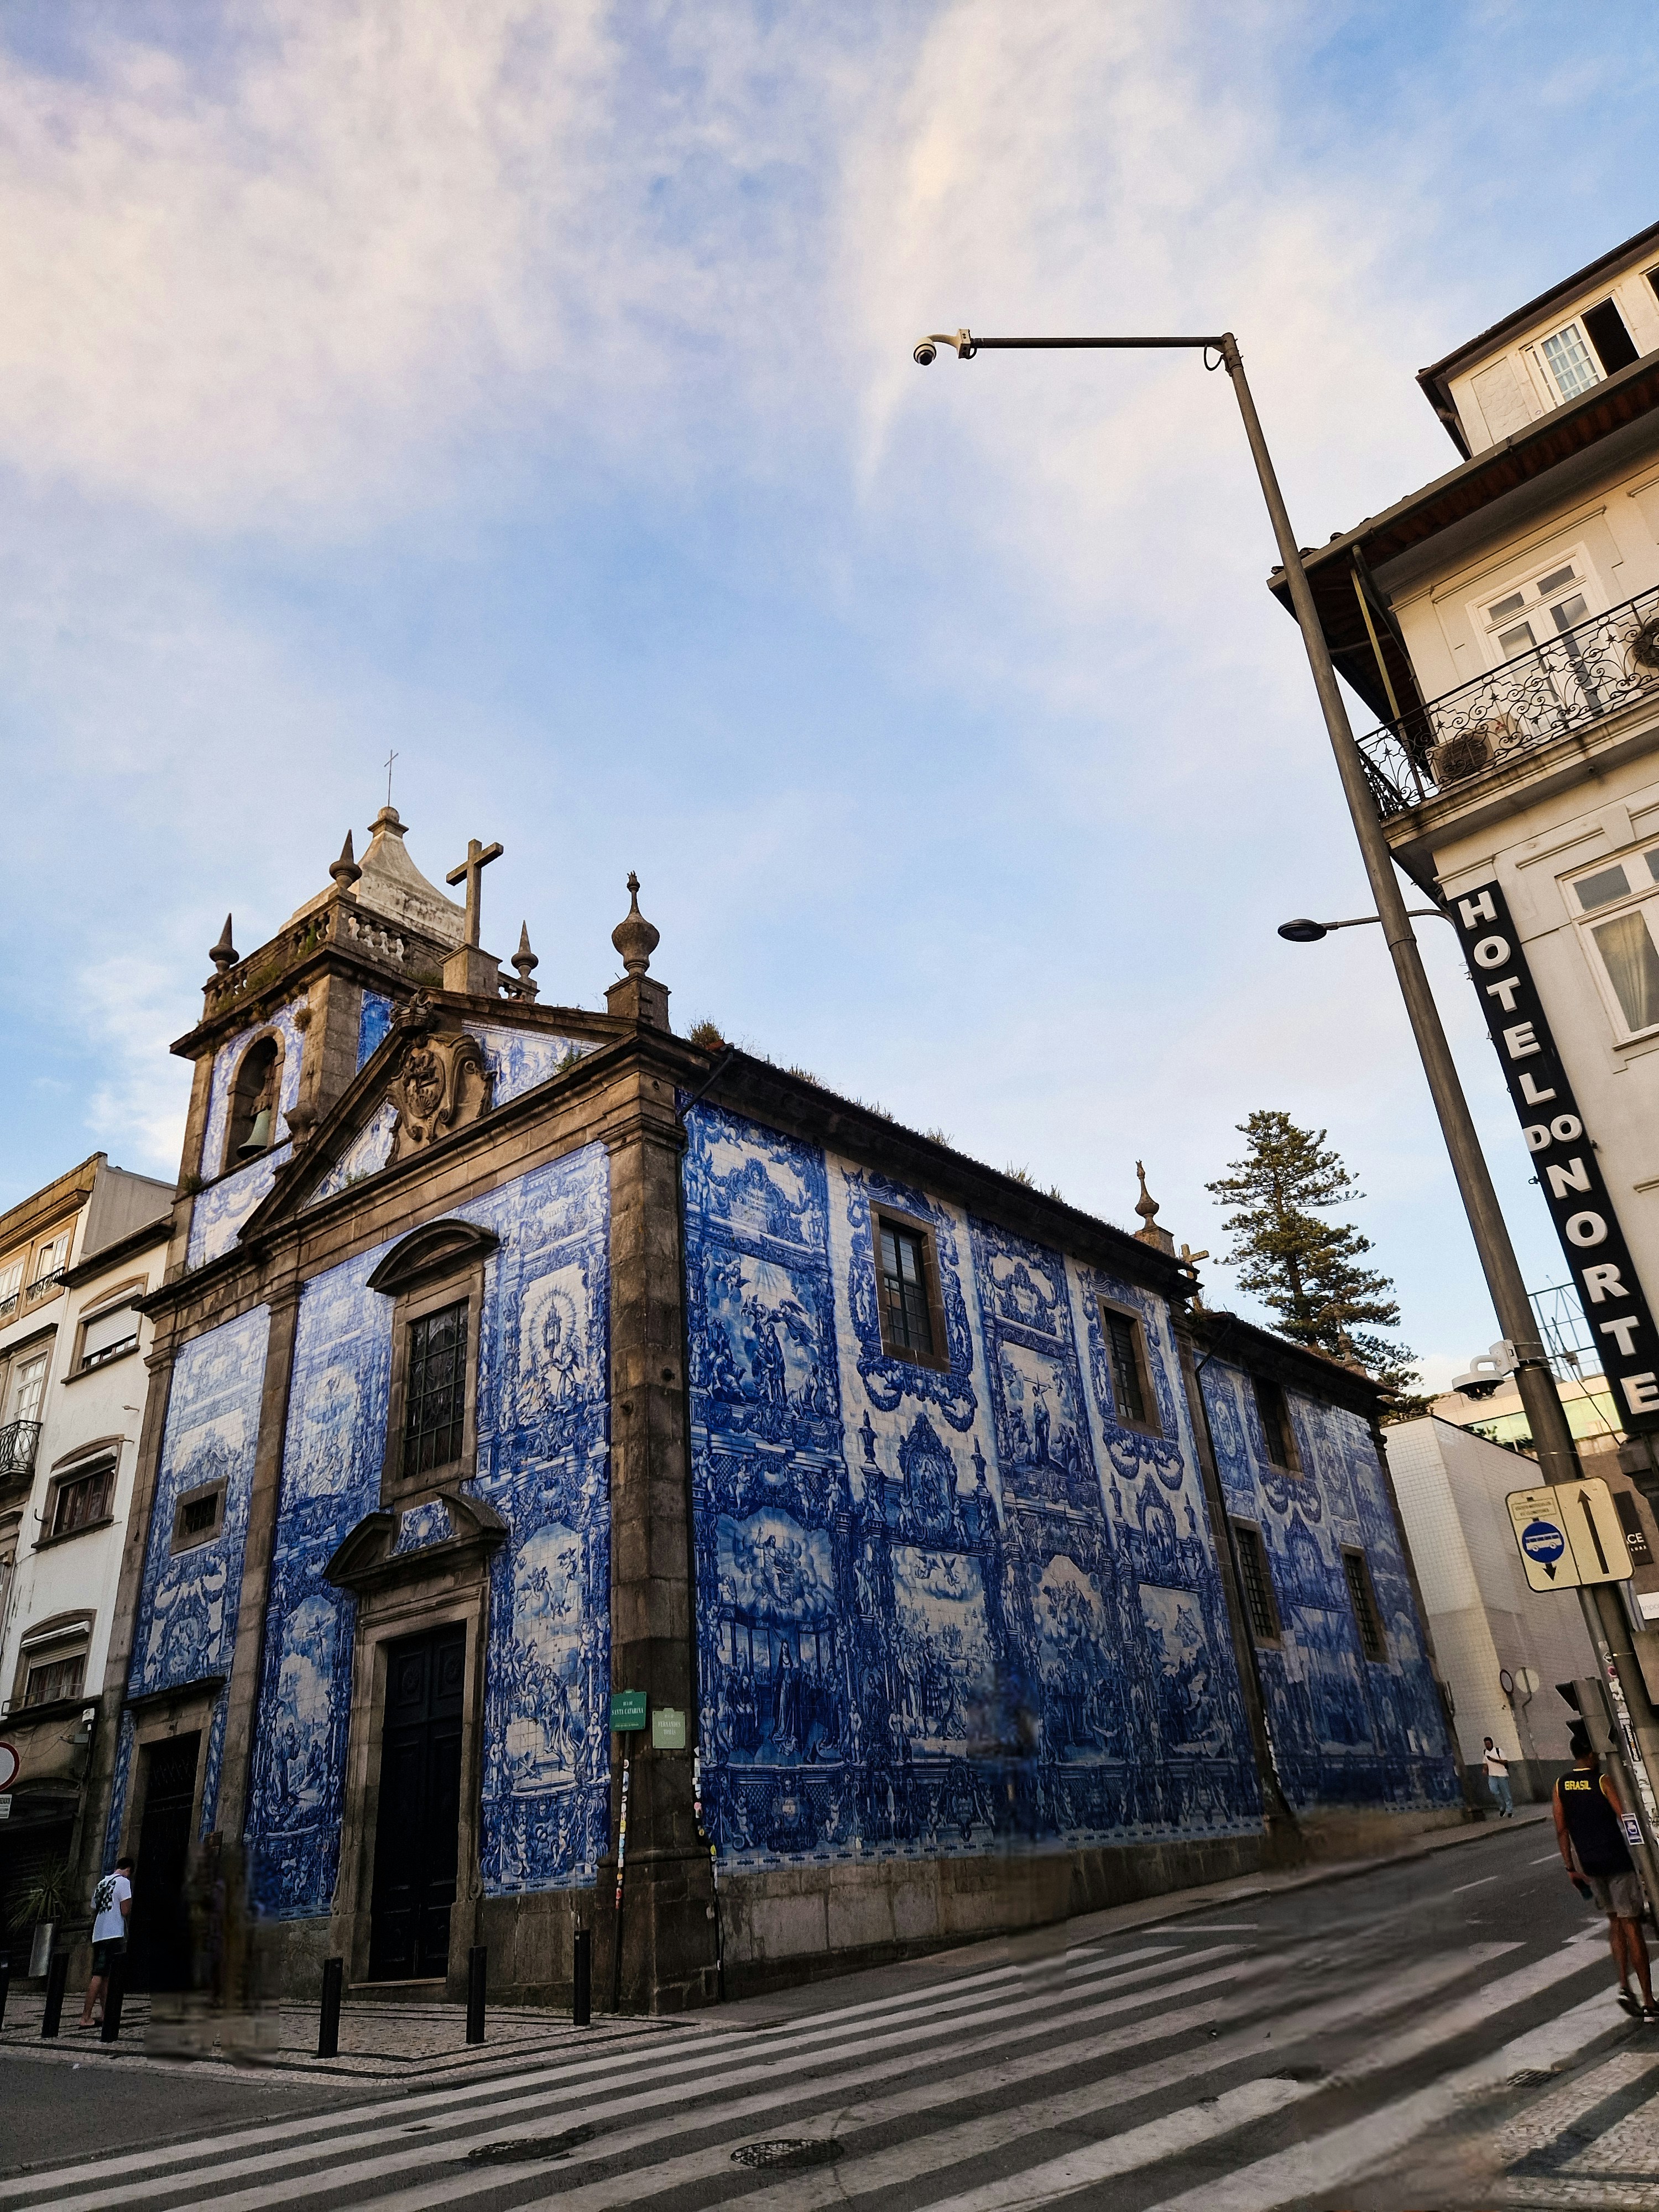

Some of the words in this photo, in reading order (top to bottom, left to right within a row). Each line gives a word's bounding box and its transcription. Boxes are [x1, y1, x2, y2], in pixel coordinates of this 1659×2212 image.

[1458, 890, 1557, 1106] HOTEL
[1522, 1114, 1582, 1152] DO
[1546, 1157, 1659, 1415] NORTE
[1626, 1532, 1645, 1544] CE
[1564, 1780, 1592, 1791] BRASIL
